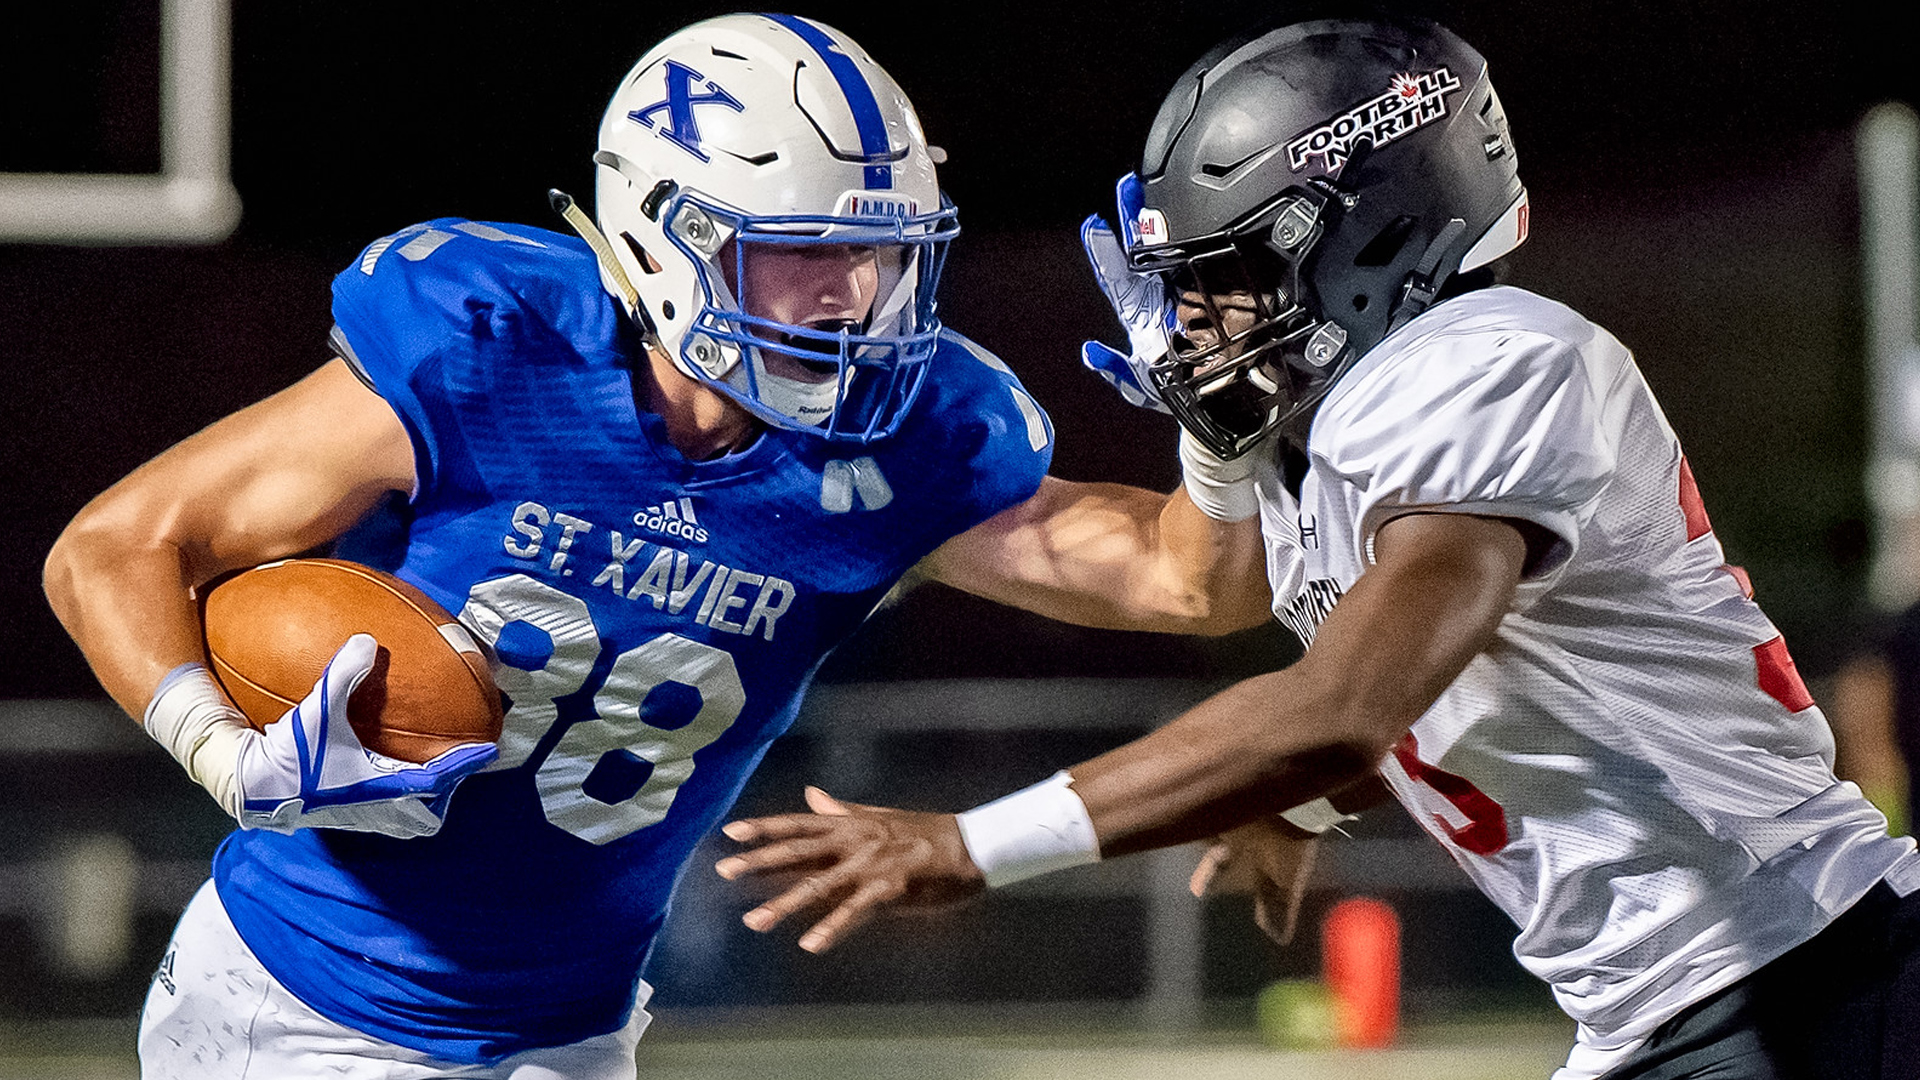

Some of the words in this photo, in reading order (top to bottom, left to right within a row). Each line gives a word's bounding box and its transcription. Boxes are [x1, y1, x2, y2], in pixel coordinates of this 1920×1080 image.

[627, 58, 746, 164] X
[503, 501, 593, 577] ST.
[592, 530, 796, 641] XAVIER
[633, 511, 709, 543] adidas
[457, 573, 747, 846] 88
